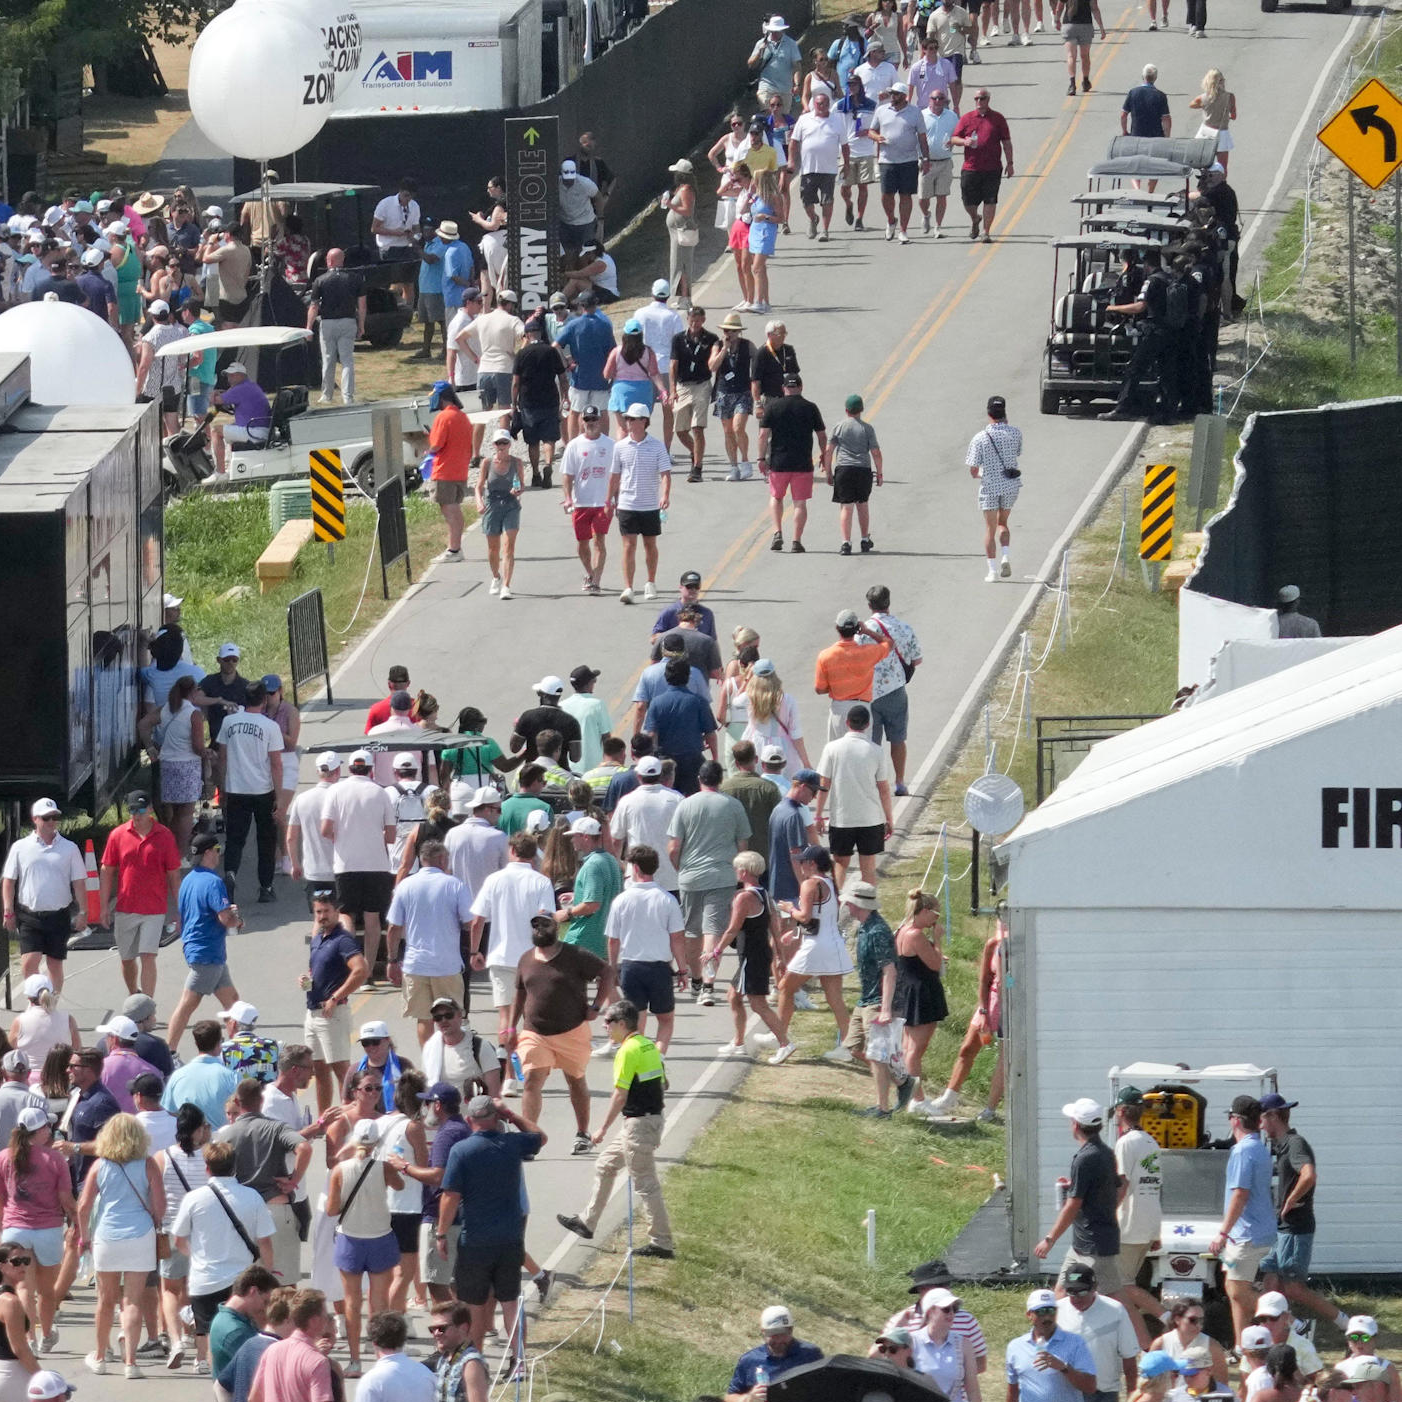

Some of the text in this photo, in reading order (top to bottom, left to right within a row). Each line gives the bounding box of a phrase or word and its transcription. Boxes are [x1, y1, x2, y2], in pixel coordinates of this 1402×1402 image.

[361, 50, 453, 81] AIM
[361, 79, 453, 89] Transportation Solutions
[518, 149, 548, 311] PARTY HOLE
[227, 722, 264, 741] OCTOBER
